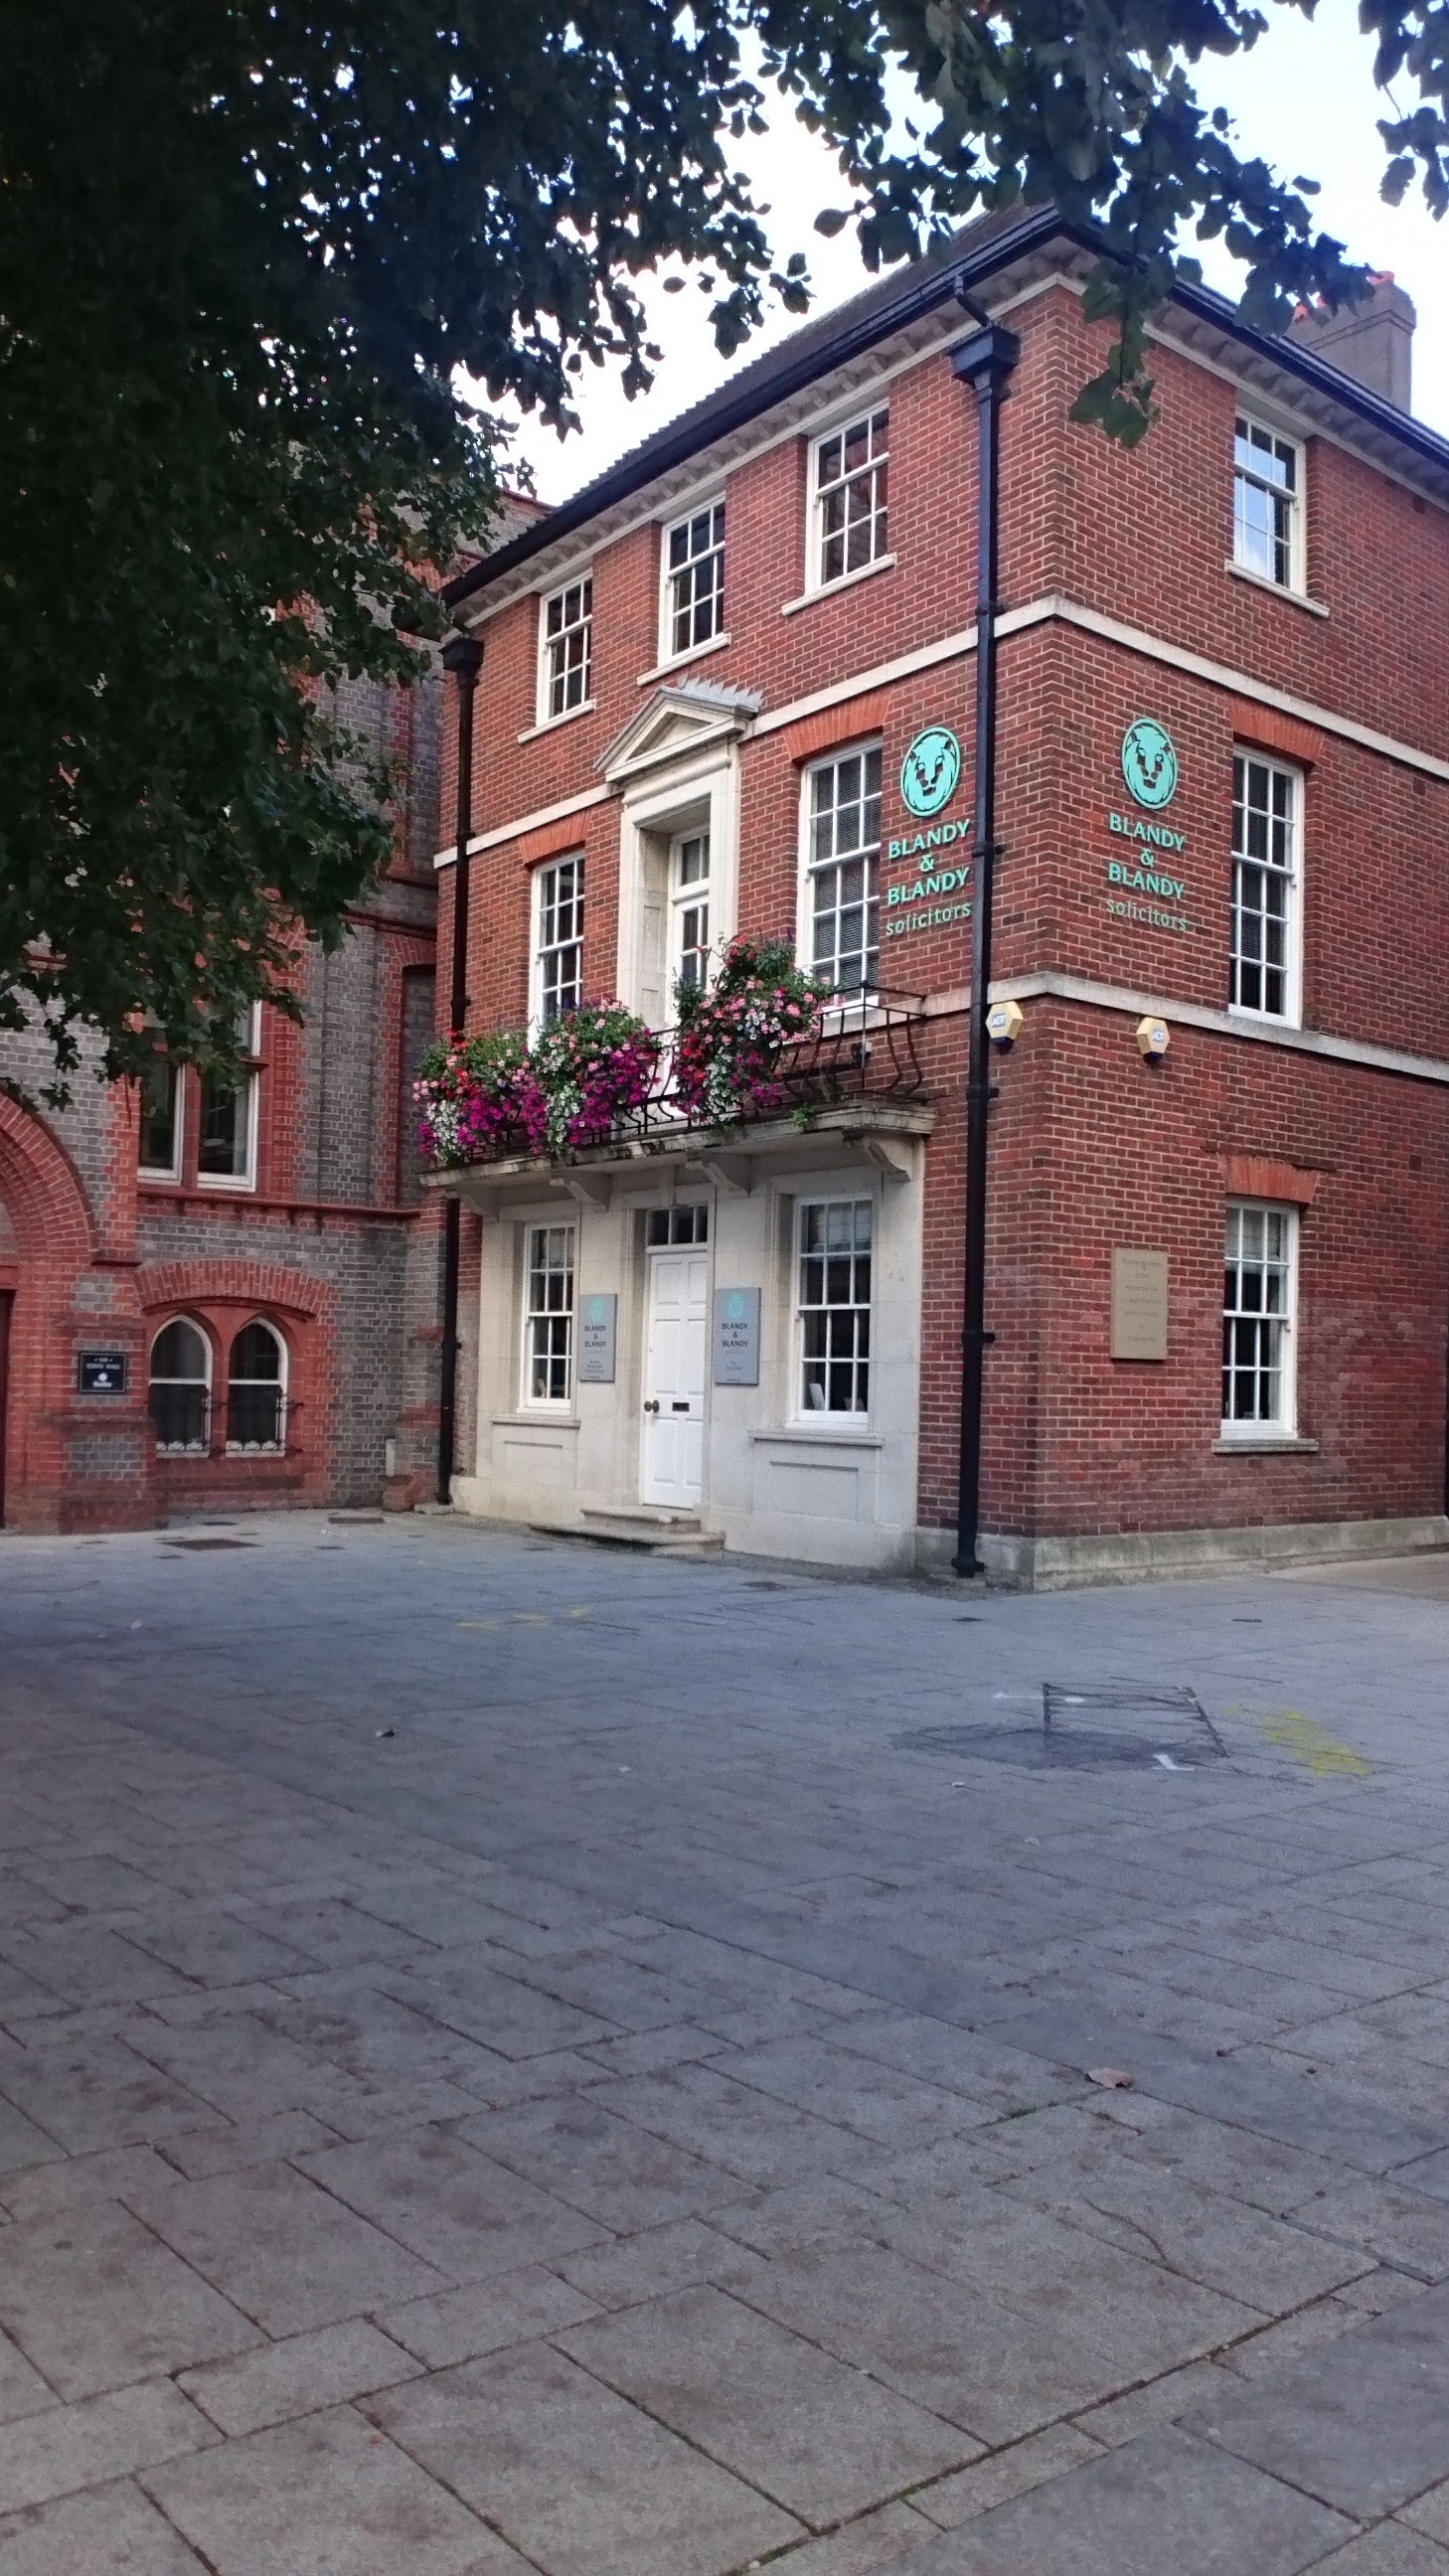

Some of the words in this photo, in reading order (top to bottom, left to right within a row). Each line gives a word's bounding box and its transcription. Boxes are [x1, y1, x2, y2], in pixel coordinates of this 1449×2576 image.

[888, 818, 970, 860] BLANDY
[1109, 811, 1186, 852] BLANDY
[919, 854, 934, 872] &
[1140, 848, 1154, 867] &
[887, 866, 970, 906] BLANDY
[1108, 862, 1185, 899] BLANDY
[886, 902, 971, 936] solicitors
[1105, 898, 1187, 931] solicitors
